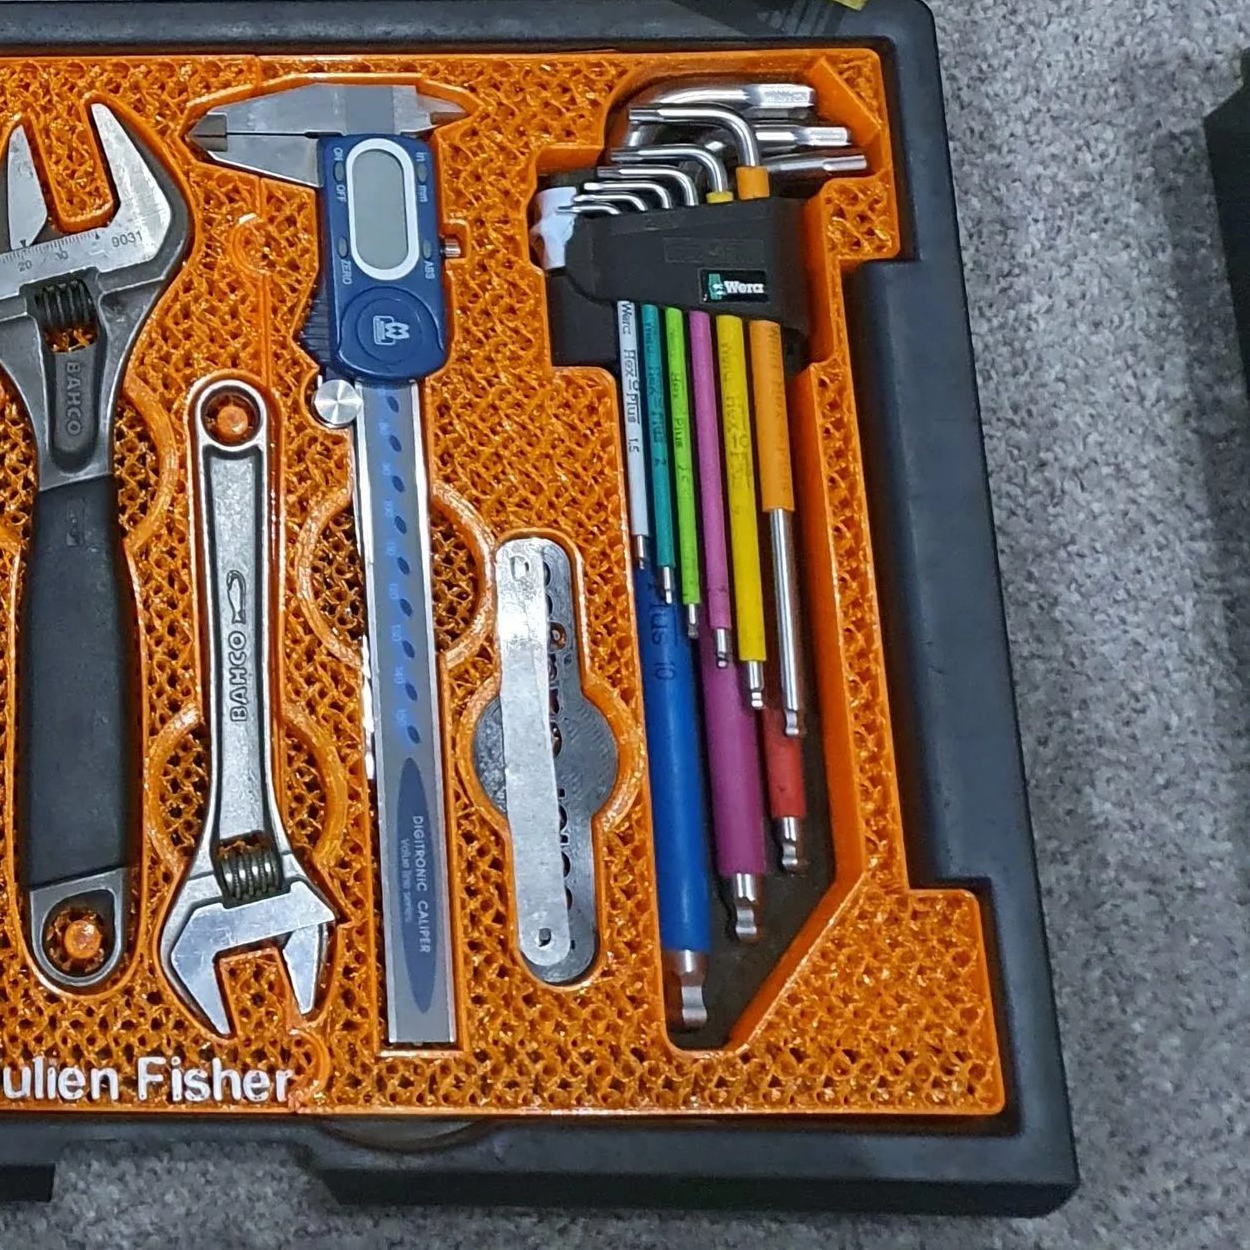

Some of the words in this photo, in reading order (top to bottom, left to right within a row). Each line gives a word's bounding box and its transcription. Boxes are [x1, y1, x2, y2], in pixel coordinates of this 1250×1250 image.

[336, 184, 347, 202] OFF
[341, 260, 352, 285] ZERO
[723, 280, 765, 294] Wera
[65, 359, 84, 438] BAHCO
[228, 631, 247, 723] BAHCO
[412, 815, 428, 892] DIGITRONIC
[417, 900, 431, 954] CALIPER
[136, 1056, 294, 1102] Fisher
